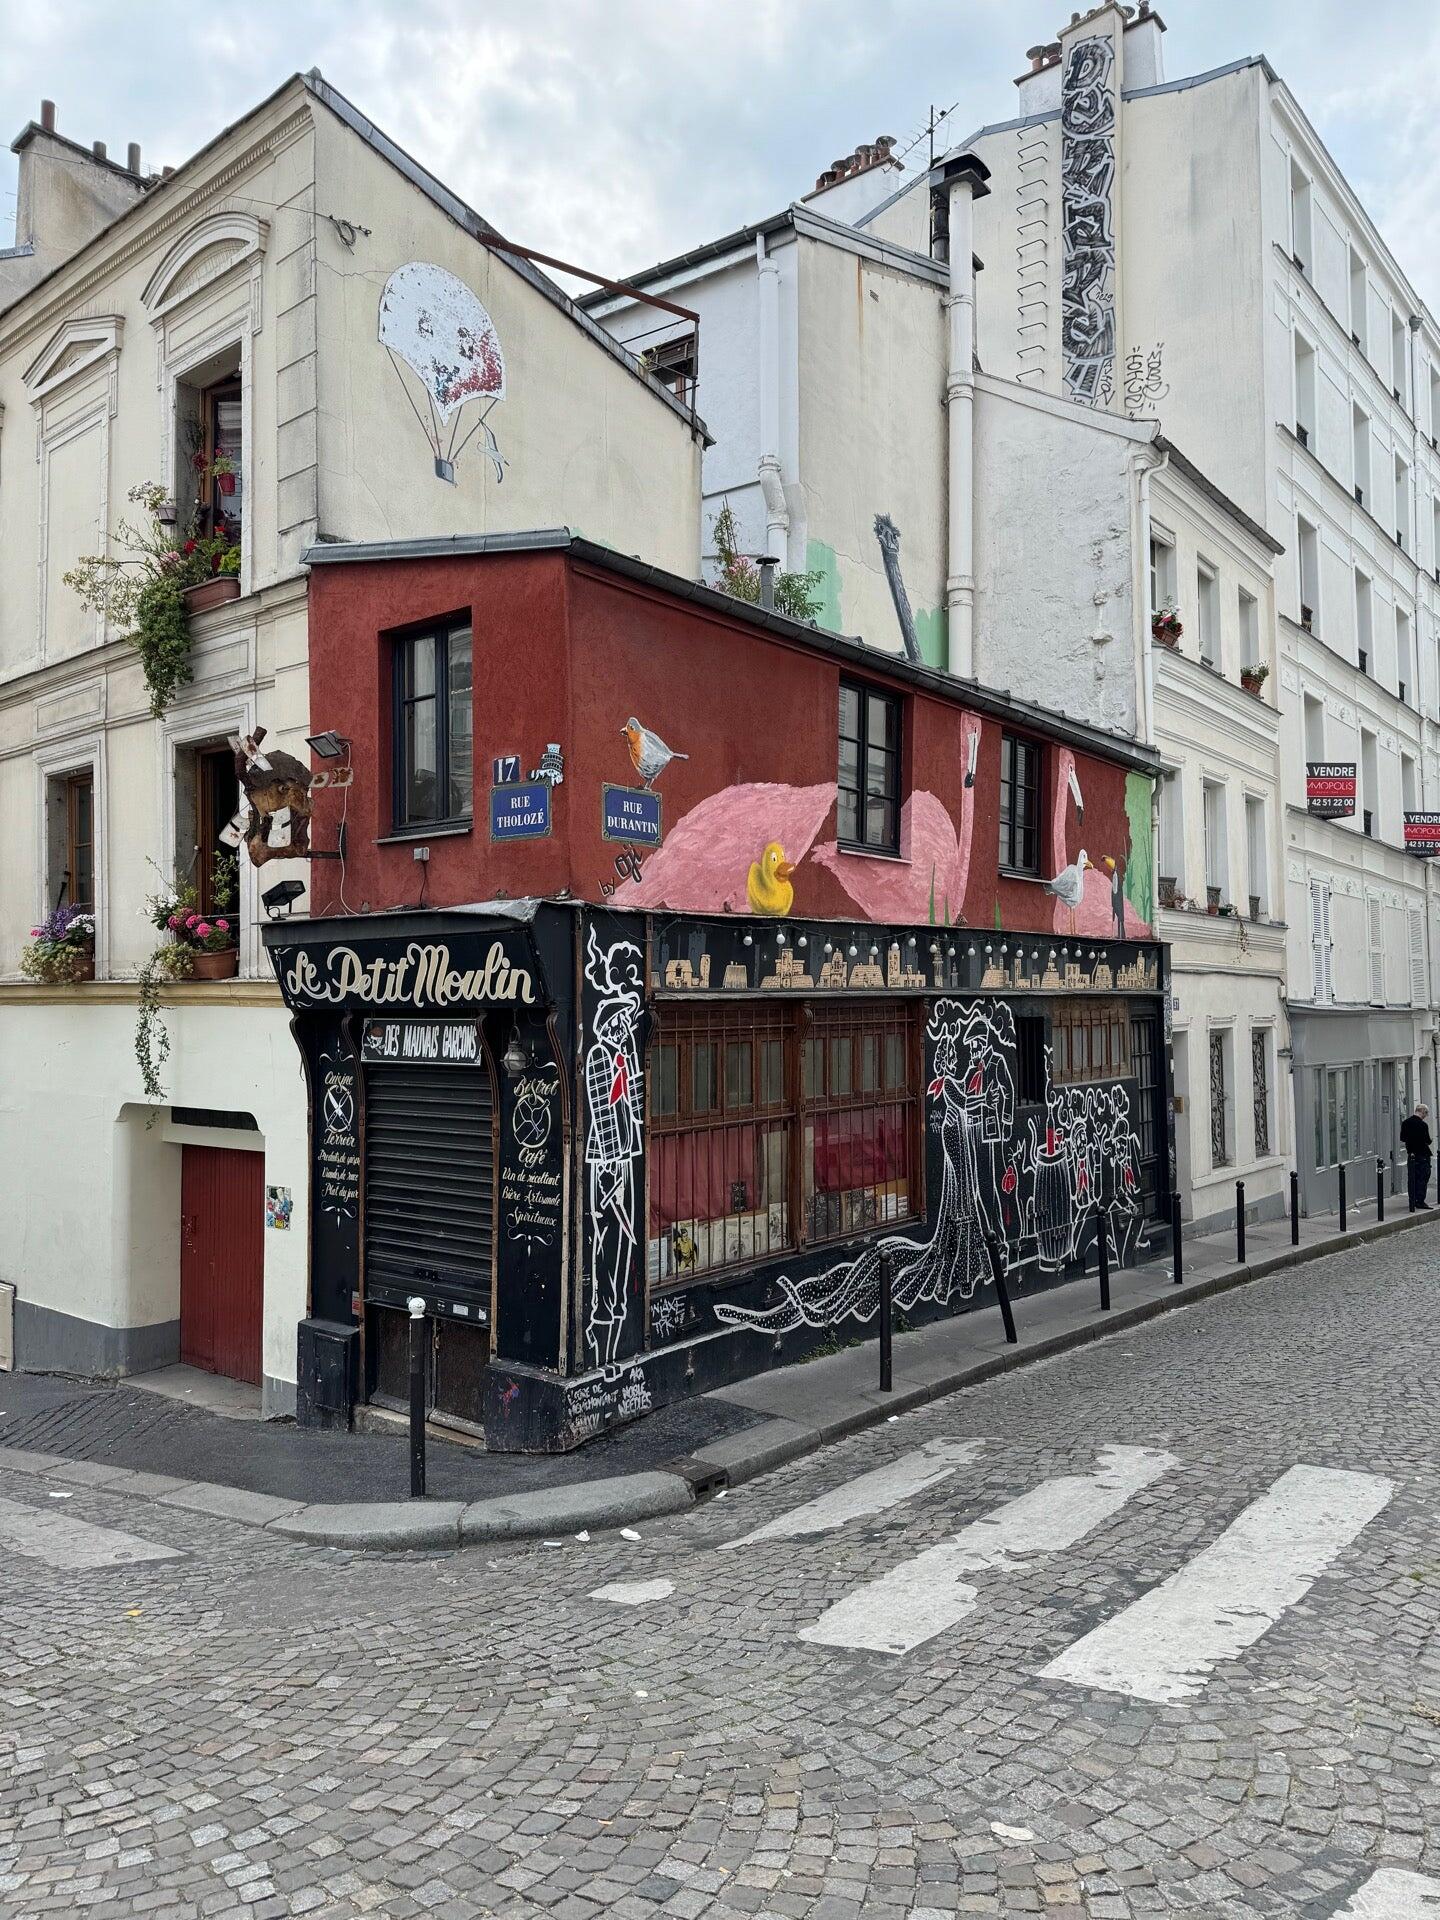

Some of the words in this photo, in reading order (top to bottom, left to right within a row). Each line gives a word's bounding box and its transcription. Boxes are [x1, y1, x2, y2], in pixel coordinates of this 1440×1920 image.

[497, 757, 516, 783] 17
[1313, 766, 1354, 777] VENDRE
[511, 796, 530, 809] RUE
[623, 800, 643, 815] RUE
[1311, 798, 1321, 806] 42
[1322, 798, 1331, 806] 51
[1333, 798, 1343, 806] 22
[1344, 798, 1354, 806] 00
[497, 808, 544, 828] THOLOZÉ
[607, 815, 658, 834] DURANTIN
[1409, 815, 1440, 824] VENDR
[1409, 840, 1417, 848] 42
[598, 877, 615, 897] by
[287, 951, 330, 1000] Le
[327, 946, 412, 1003] Petit
[407, 941, 536, 1008] Moulin
[384, 1025, 400, 1056] DES
[402, 1025, 439, 1057] MAUVAIS
[442, 1025, 477, 1060] GARÇONS
[325, 1071, 354, 1093] Cuisine
[513, 1075, 559, 1105] Bistrot
[324, 1128, 355, 1147] Terroir
[518, 1147, 548, 1169] Café
[503, 1167, 516, 1180] Vin
[517, 1169, 525, 1181] de
[527, 1171, 561, 1185] récoltant
[502, 1186, 521, 1200] Bière
[524, 1190, 561, 1206] Artisanale
[506, 1206, 557, 1228] Spiritueux
[630, 1366, 645, 1382] AKA
[592, 1383, 603, 1394] DE
